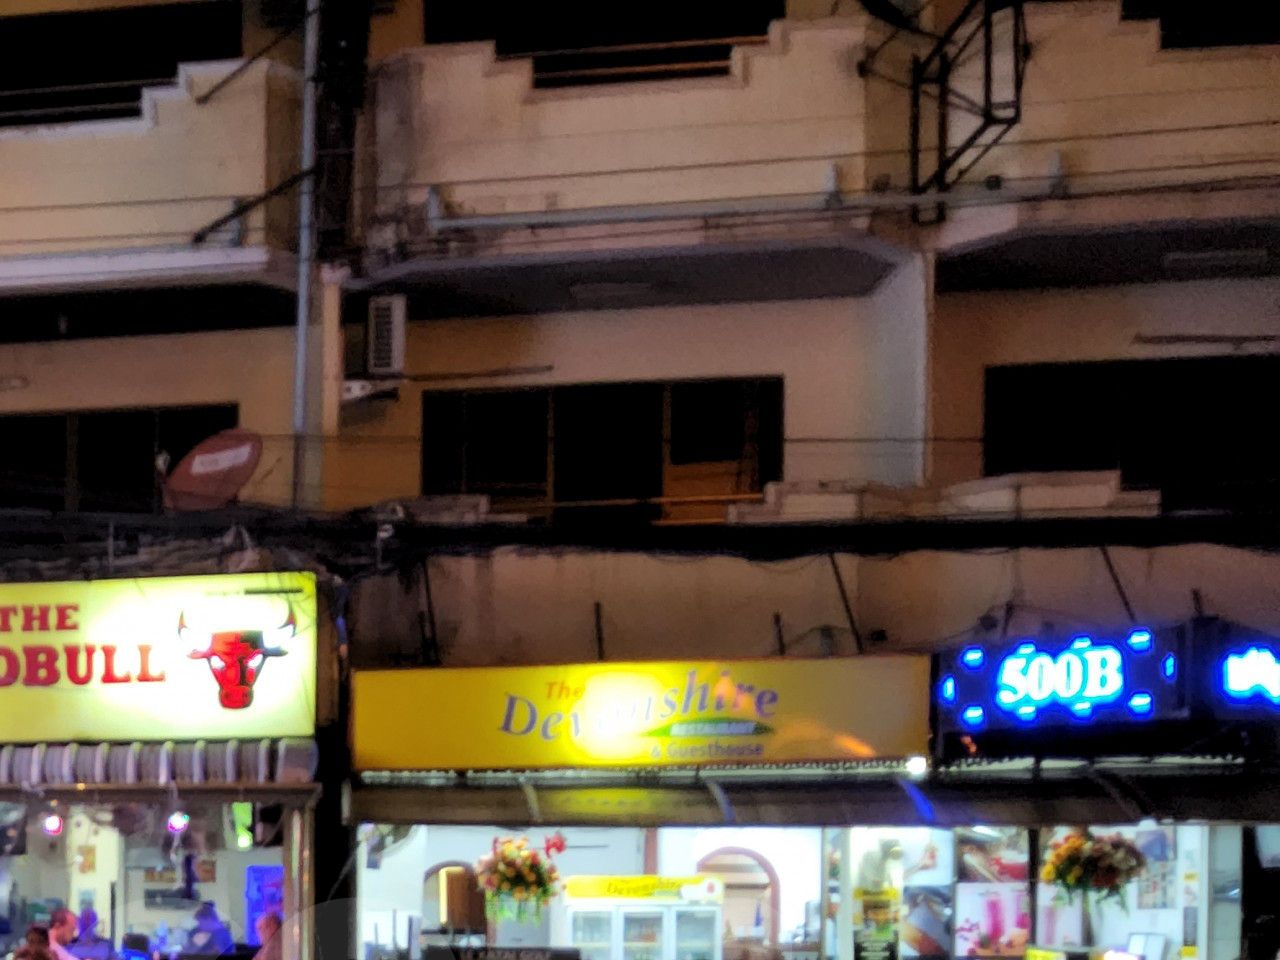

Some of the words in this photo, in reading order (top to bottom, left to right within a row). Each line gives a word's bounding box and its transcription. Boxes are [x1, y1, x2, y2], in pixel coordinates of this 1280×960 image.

[545, 680, 586, 701] The
[998, 645, 1124, 704] 500B
[497, 669, 779, 742] Devnshire
